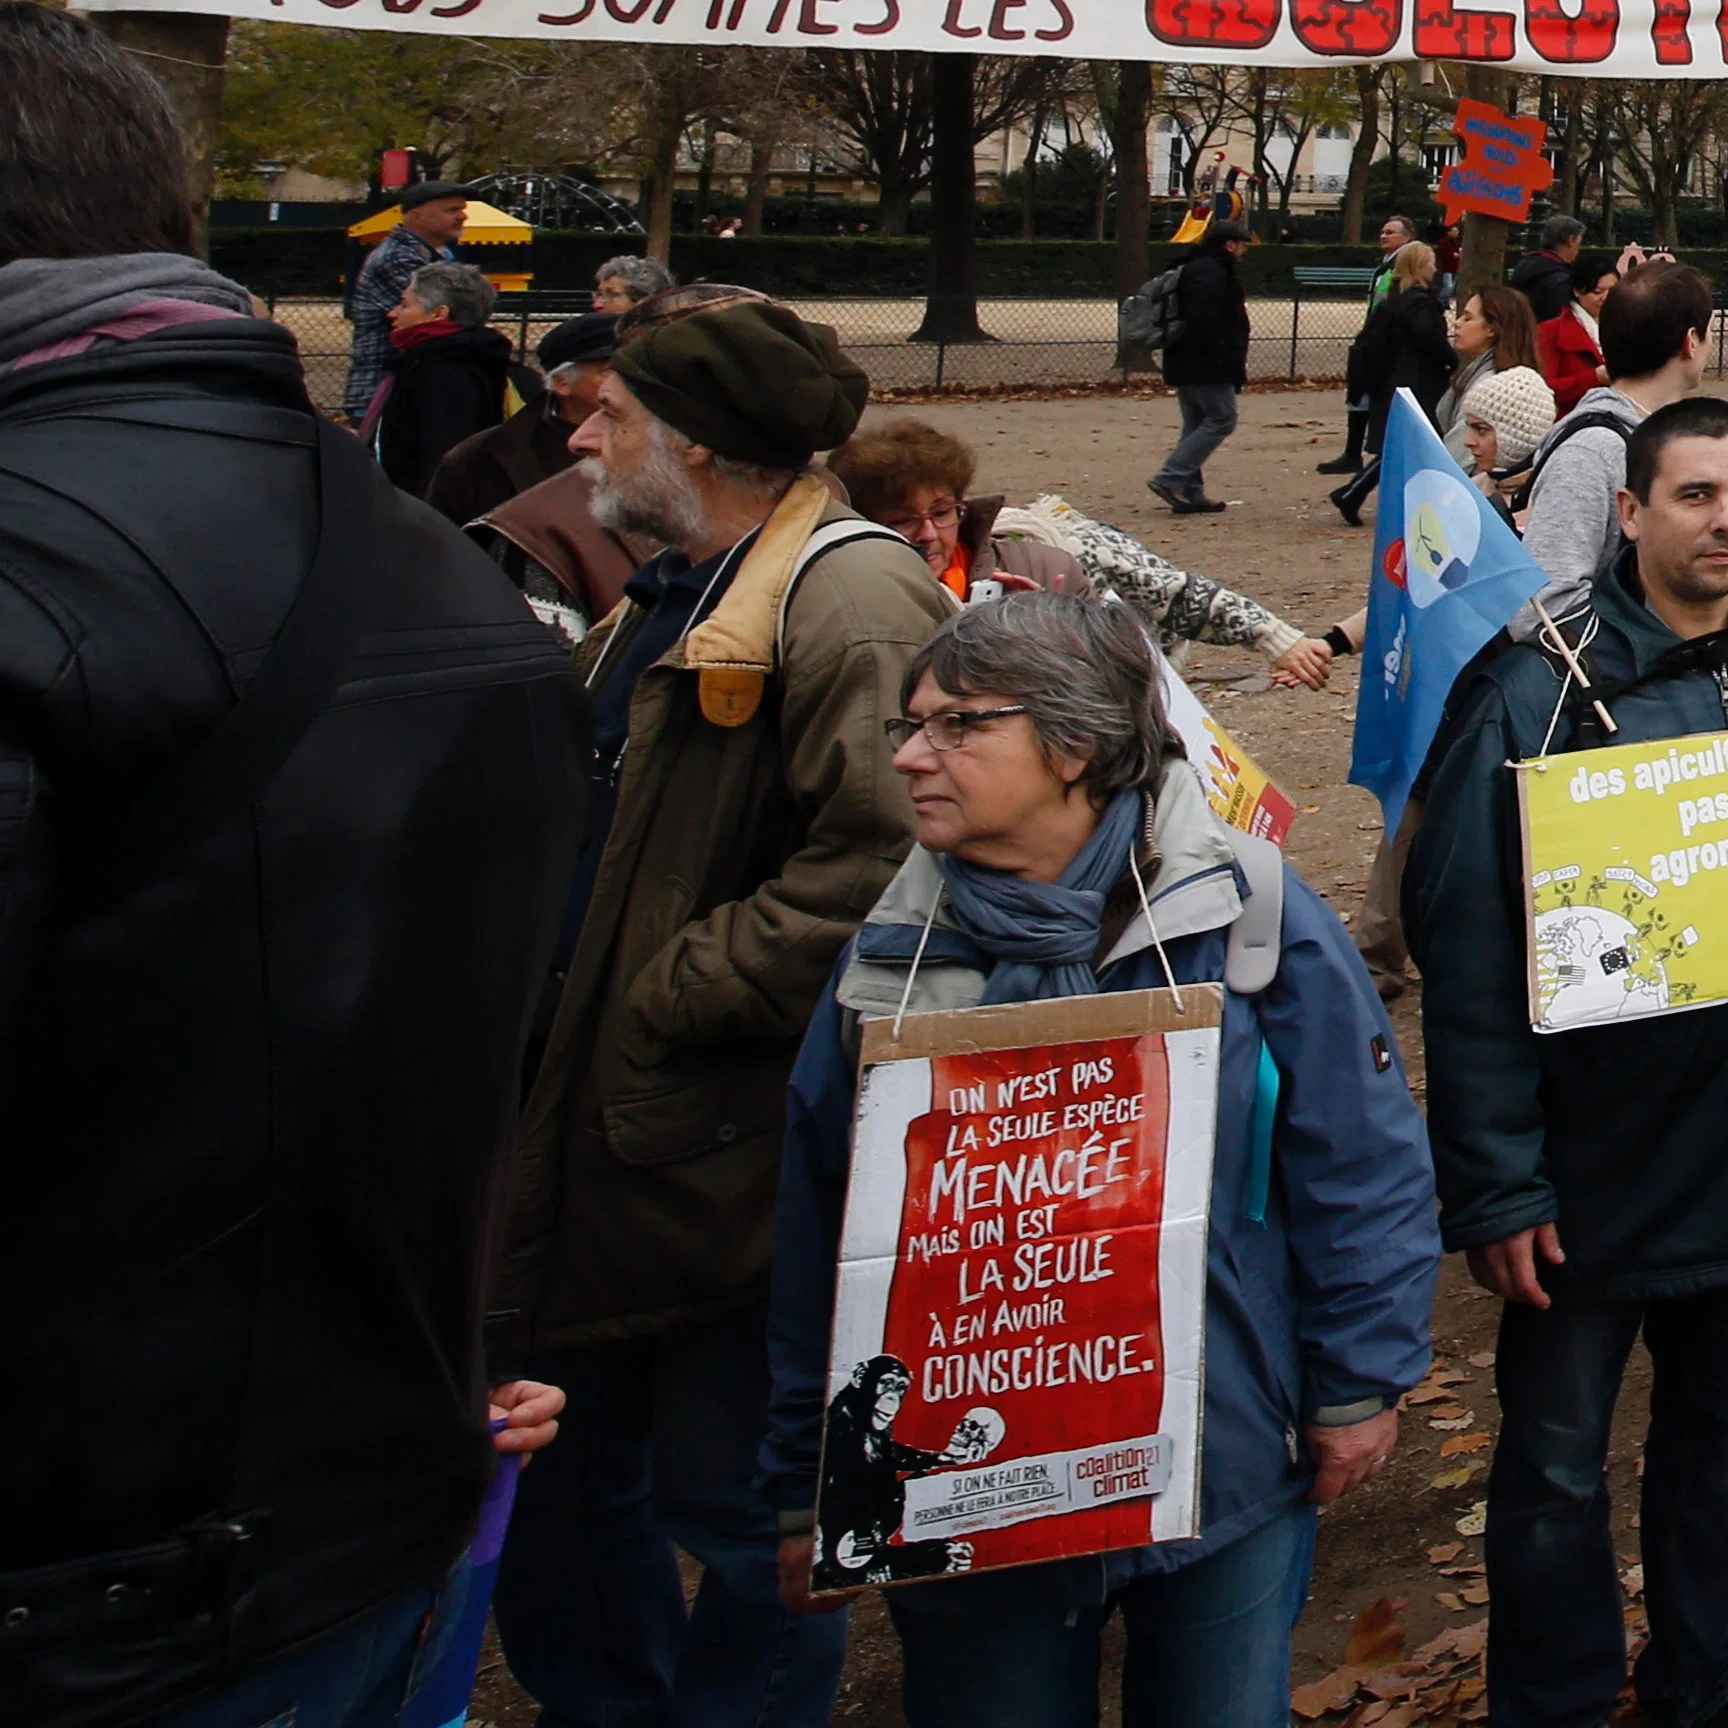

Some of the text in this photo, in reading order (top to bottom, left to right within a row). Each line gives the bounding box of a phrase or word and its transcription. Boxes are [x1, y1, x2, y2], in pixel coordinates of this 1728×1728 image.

[1568, 766, 1627, 804] des
[949, 1056, 1115, 1117] ON N'EST PAS
[945, 1092, 1147, 1159] LA SEULE ESPÈCE
[969, 1212, 1005, 1250] ON
[1015, 1203, 1062, 1240] EST
[957, 1233, 1115, 1306] LA SEULE
[927, 1292, 1069, 1350] À EN AVOIR
[963, 1474, 981, 1493] ON
[982, 1470, 997, 1490] NE
